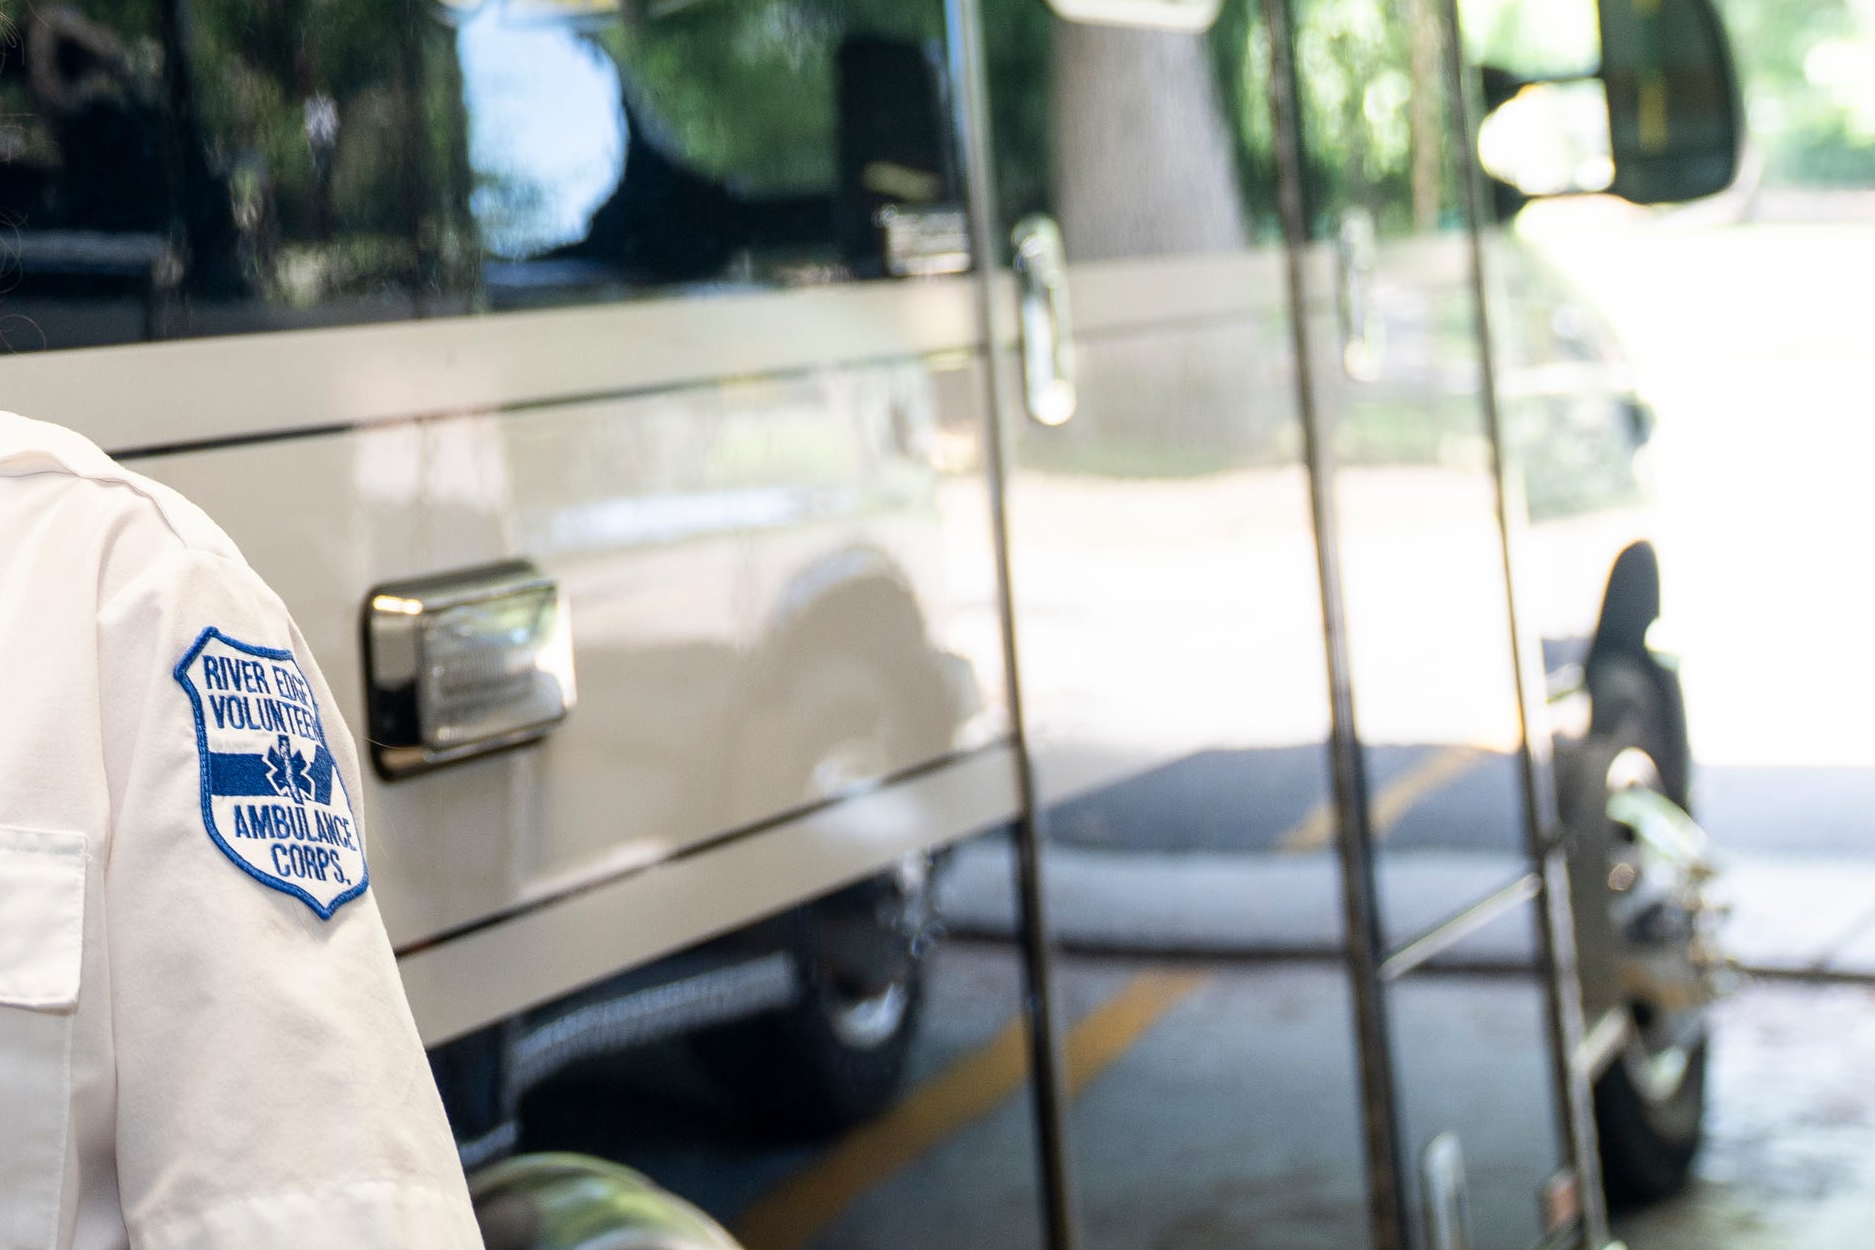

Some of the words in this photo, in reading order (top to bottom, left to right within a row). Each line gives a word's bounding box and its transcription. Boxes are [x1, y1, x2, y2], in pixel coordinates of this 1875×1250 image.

[203, 655, 271, 695] RIVER
[273, 665, 312, 709] EDGE
[233, 805, 357, 851] AMBULANCE
